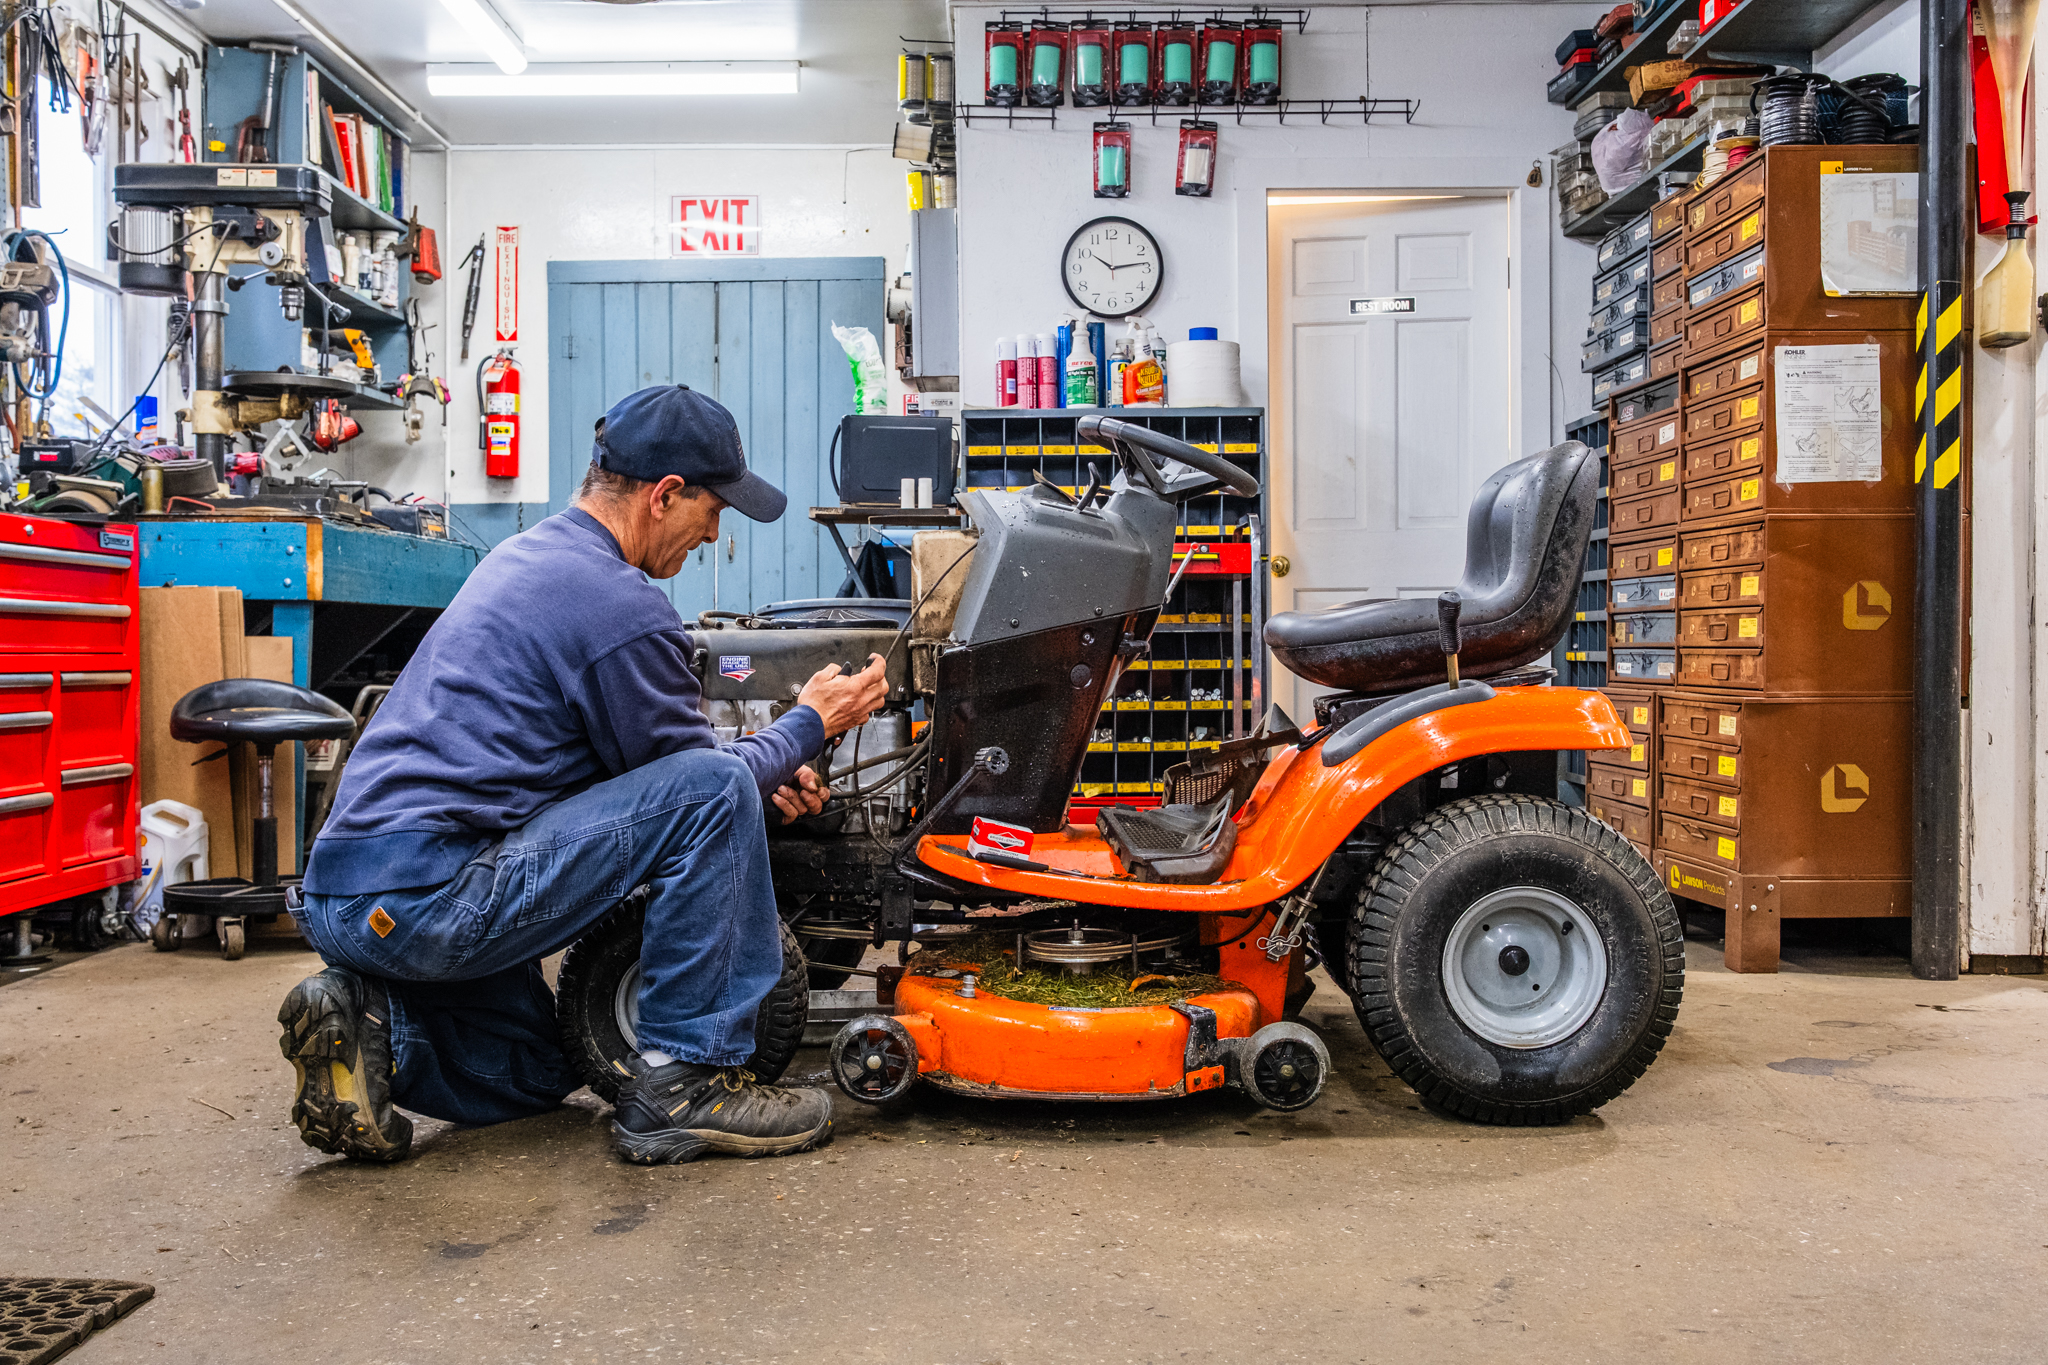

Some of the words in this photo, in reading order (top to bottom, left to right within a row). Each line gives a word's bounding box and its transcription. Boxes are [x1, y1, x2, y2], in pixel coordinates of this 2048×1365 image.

[681, 199, 749, 251] EXIT
[498, 234, 516, 244] FIRE
[1091, 234, 1100, 245] 11
[1105, 229, 1118, 240] 12
[1127, 234, 1131, 244] 1
[1078, 248, 1092, 259] 10
[1137, 245, 1145, 256] 2
[1072, 263, 1082, 275] 9
[1142, 262, 1151, 274] 3
[1078, 280, 1088, 291] 8
[1136, 280, 1146, 291] 4
[1092, 293, 1101, 304] 7
[1107, 297, 1117, 308] 6
[1124, 292, 1134, 303] 5
[1355, 302, 1379, 312] REST
[1382, 300, 1410, 311] ROOM
[1682, 874, 1704, 889] LAWSON
[1703, 880, 1726, 896] Products
